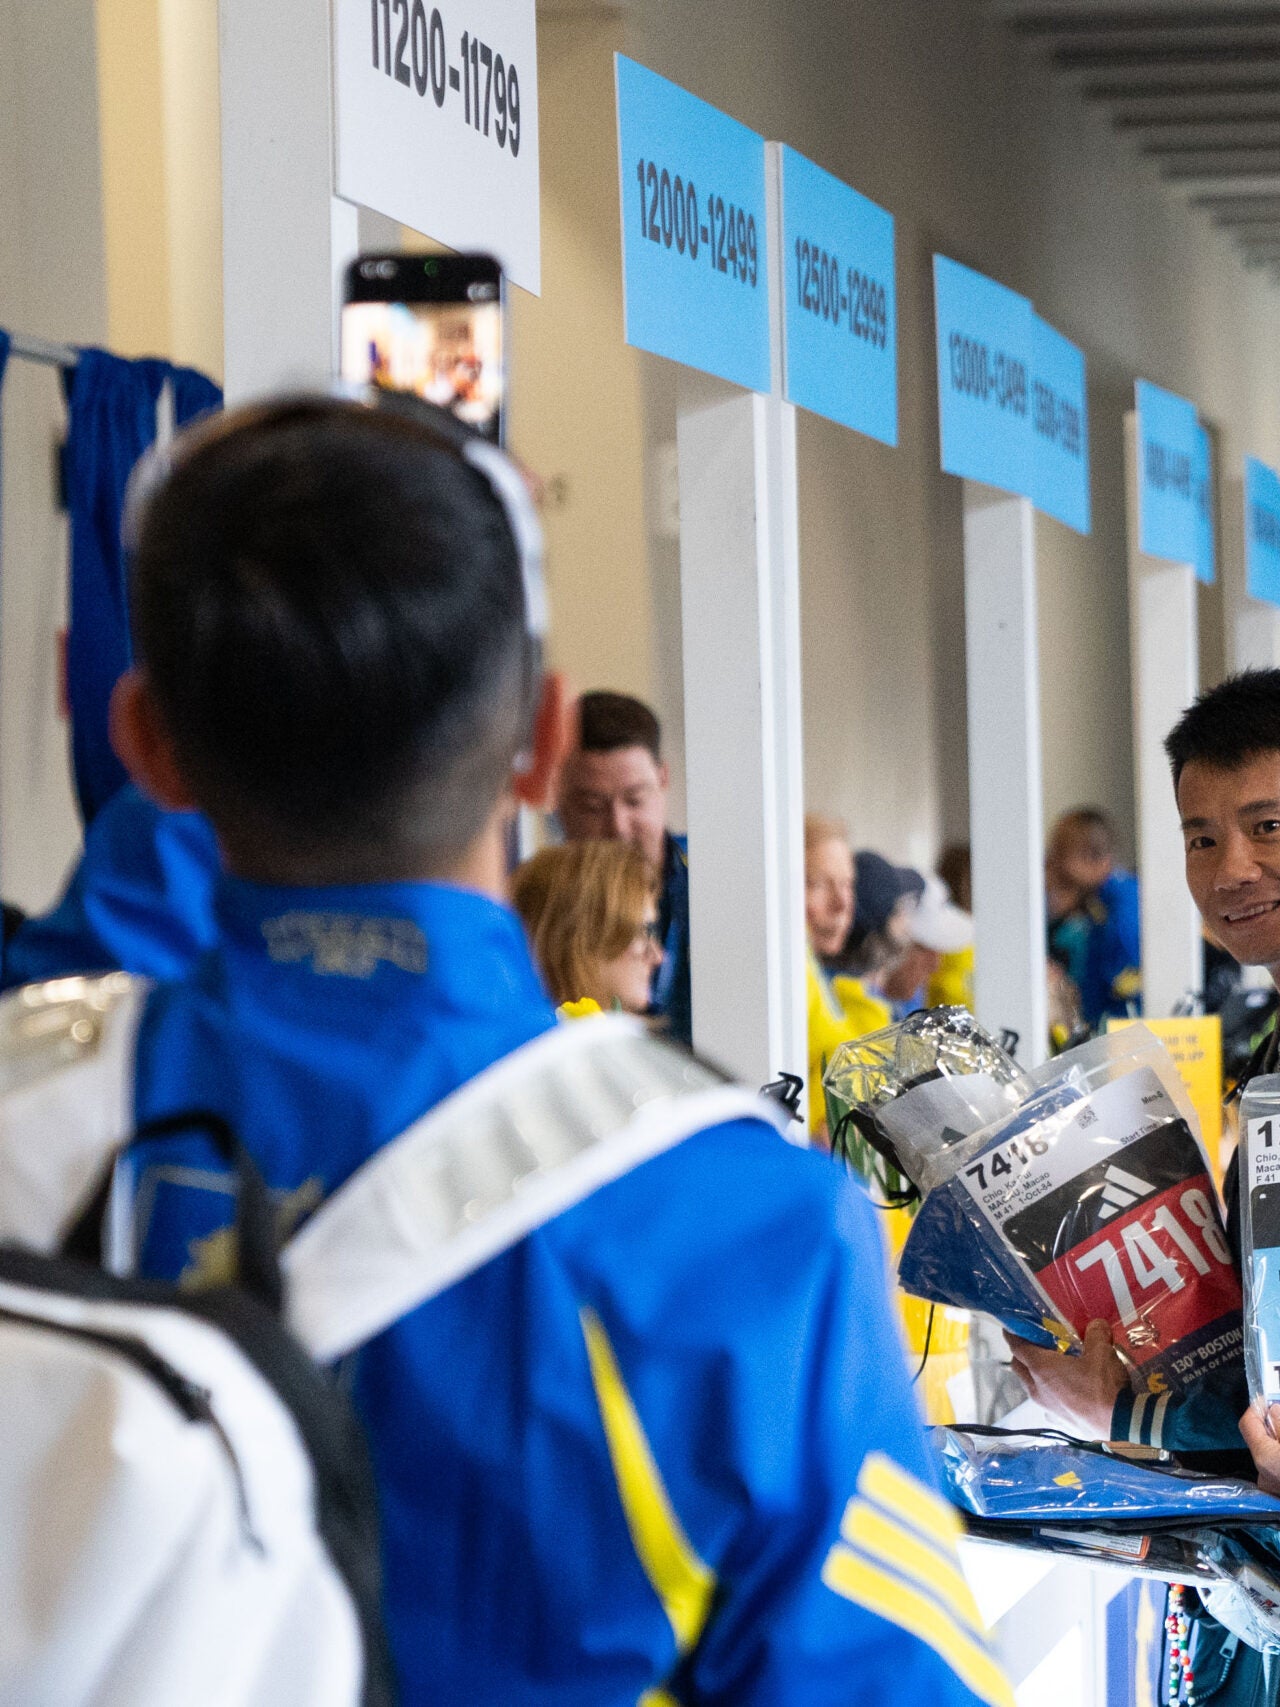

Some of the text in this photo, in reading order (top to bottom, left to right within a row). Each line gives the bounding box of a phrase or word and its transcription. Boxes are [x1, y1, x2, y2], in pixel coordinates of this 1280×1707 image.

[370, 0, 520, 158] 11200-11799
[637, 158, 758, 288] 12000-12499
[795, 236, 887, 351] 12500-12999
[1120, 1130, 1139, 1146] Start
[1255, 1153, 1280, 1164] Chio,
[1256, 1175, 1263, 1185] F
[1264, 1173, 1276, 1183] 41
[1074, 1190, 1233, 1328] 7418
[1196, 1327, 1243, 1360] BOSTON
[1182, 1365, 1208, 1384] BANK
[1208, 1359, 1220, 1369] OF
